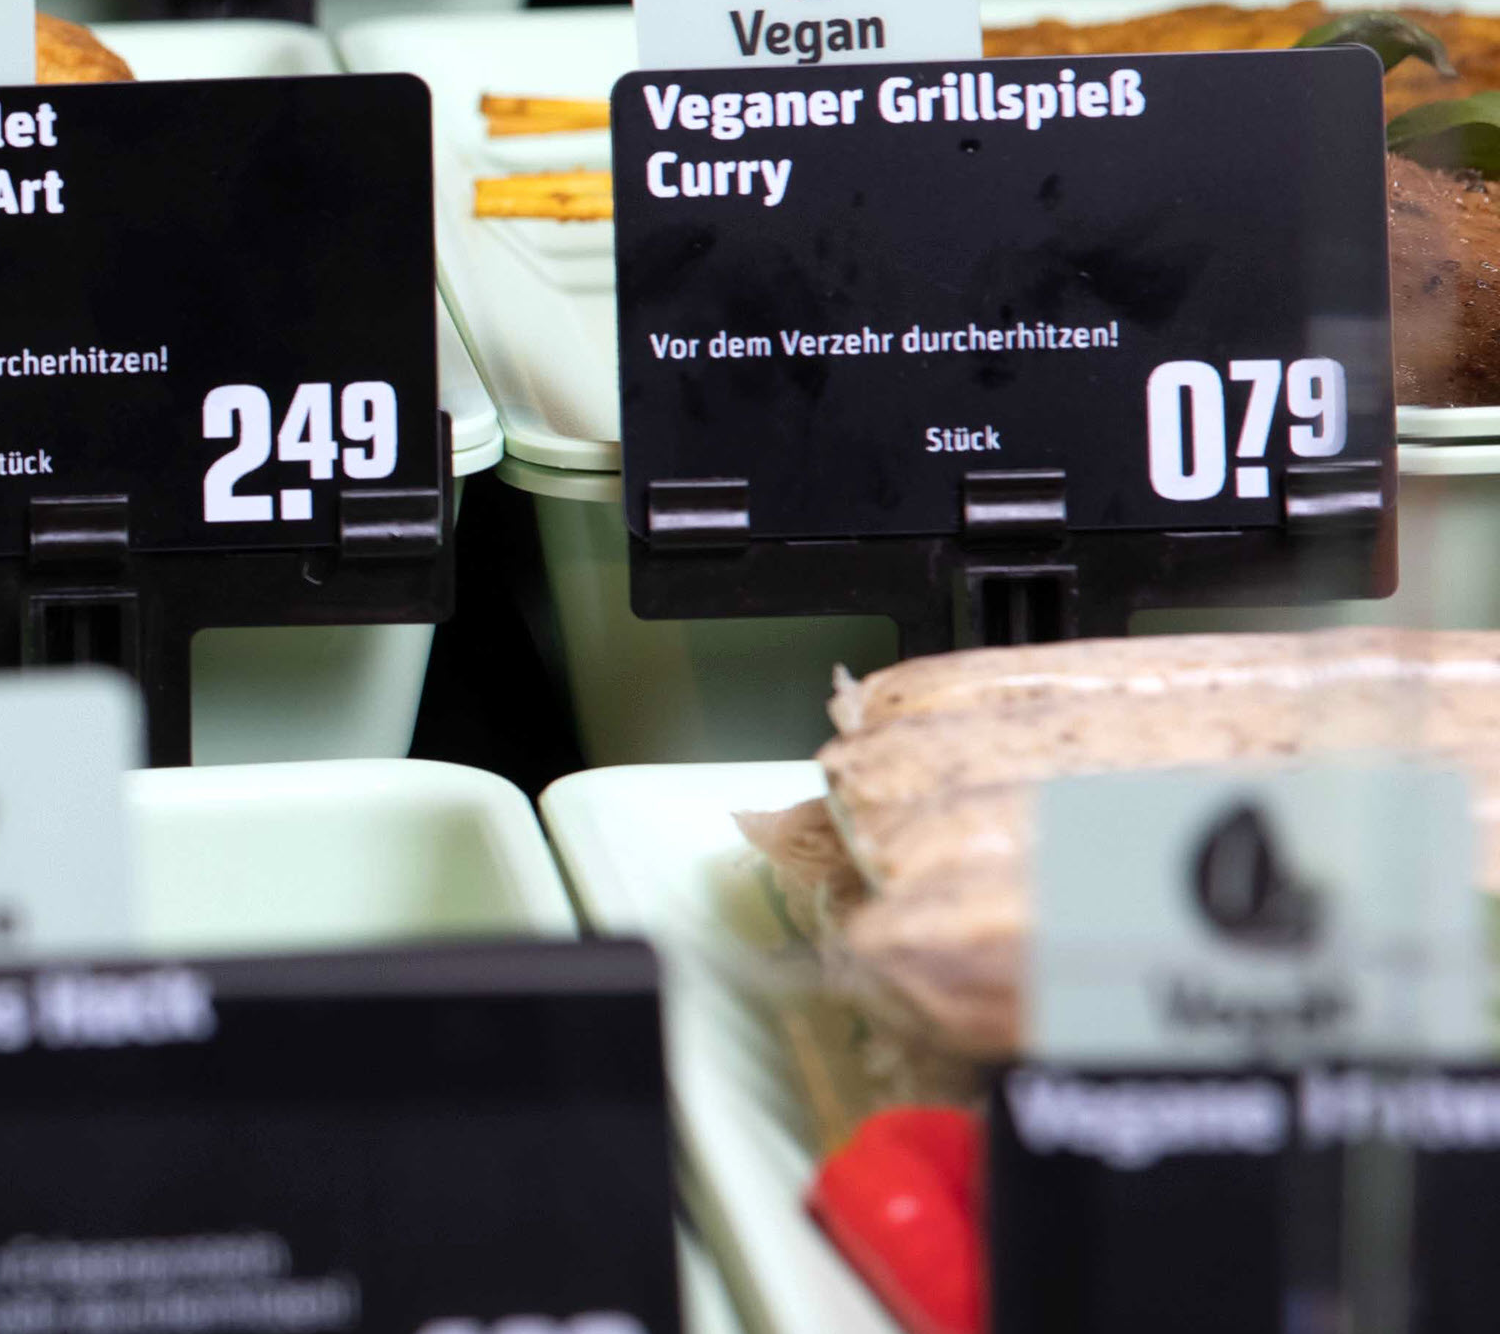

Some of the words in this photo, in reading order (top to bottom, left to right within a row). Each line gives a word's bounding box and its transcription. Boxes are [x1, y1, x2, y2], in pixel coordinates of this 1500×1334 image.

[729, 9, 885, 65] Vegan
[642, 83, 864, 141] Veganer
[878, 68, 1146, 131] Grillspieß
[646, 151, 793, 207] Curry
[649, 333, 700, 360] Vor
[708, 330, 772, 359] dem
[779, 326, 894, 356] Verzehr
[901, 320, 1119, 354] durcherhitzen!
[202, 380, 402, 523] 2.49
[925, 425, 1001, 453] Stück
[1146, 356, 1351, 505] 0.79
